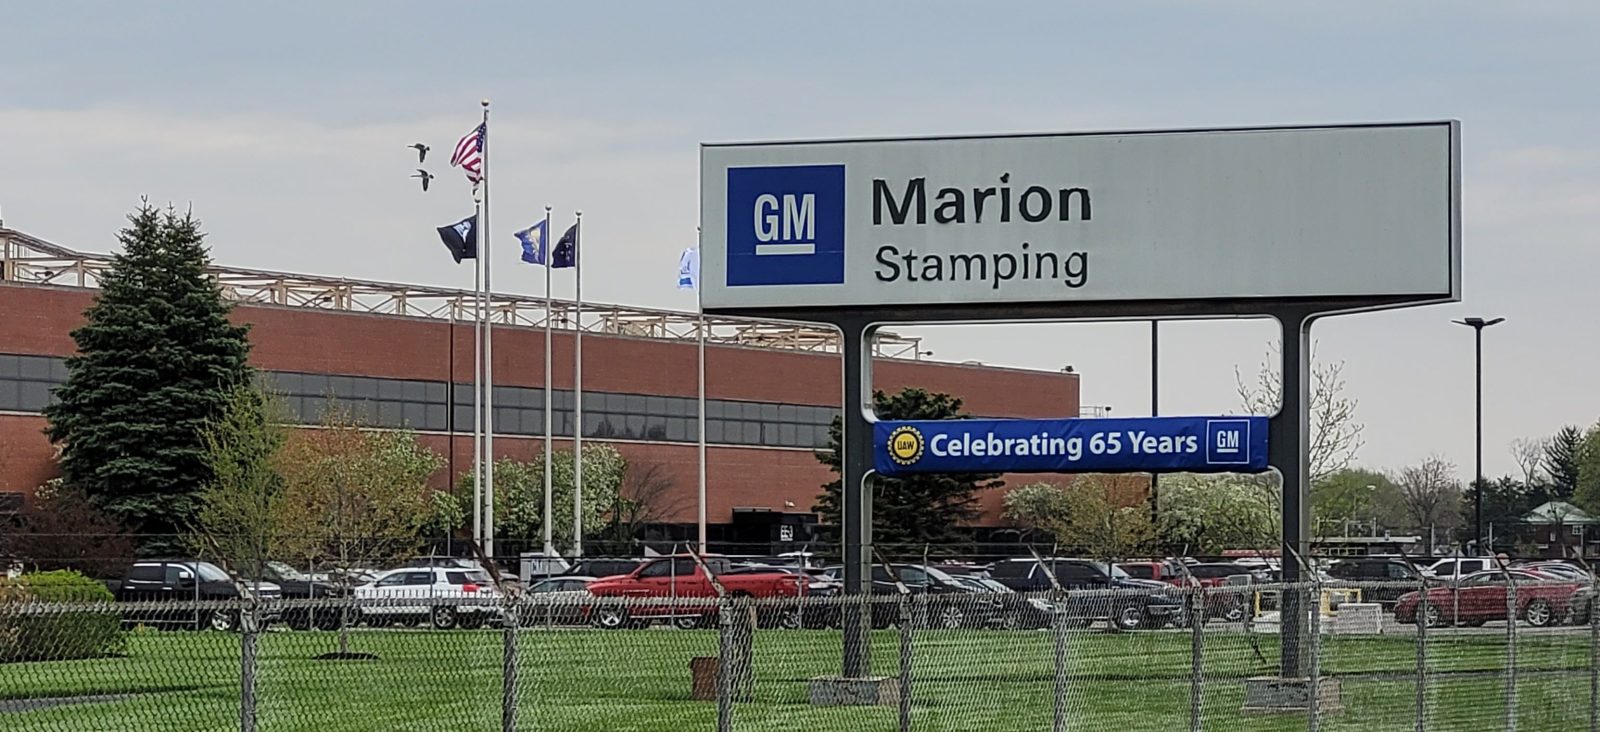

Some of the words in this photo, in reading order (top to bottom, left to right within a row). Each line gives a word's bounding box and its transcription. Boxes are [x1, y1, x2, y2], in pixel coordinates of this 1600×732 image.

[754, 193, 815, 241] GM
[872, 173, 1091, 225] Marion
[874, 242, 1088, 289] Stamping
[897, 440, 915, 451] UAW
[930, 433, 1083, 461] Celebrating
[1089, 432, 1122, 455] 65
[1127, 431, 1198, 454] Years
[1217, 431, 1239, 448] GM
